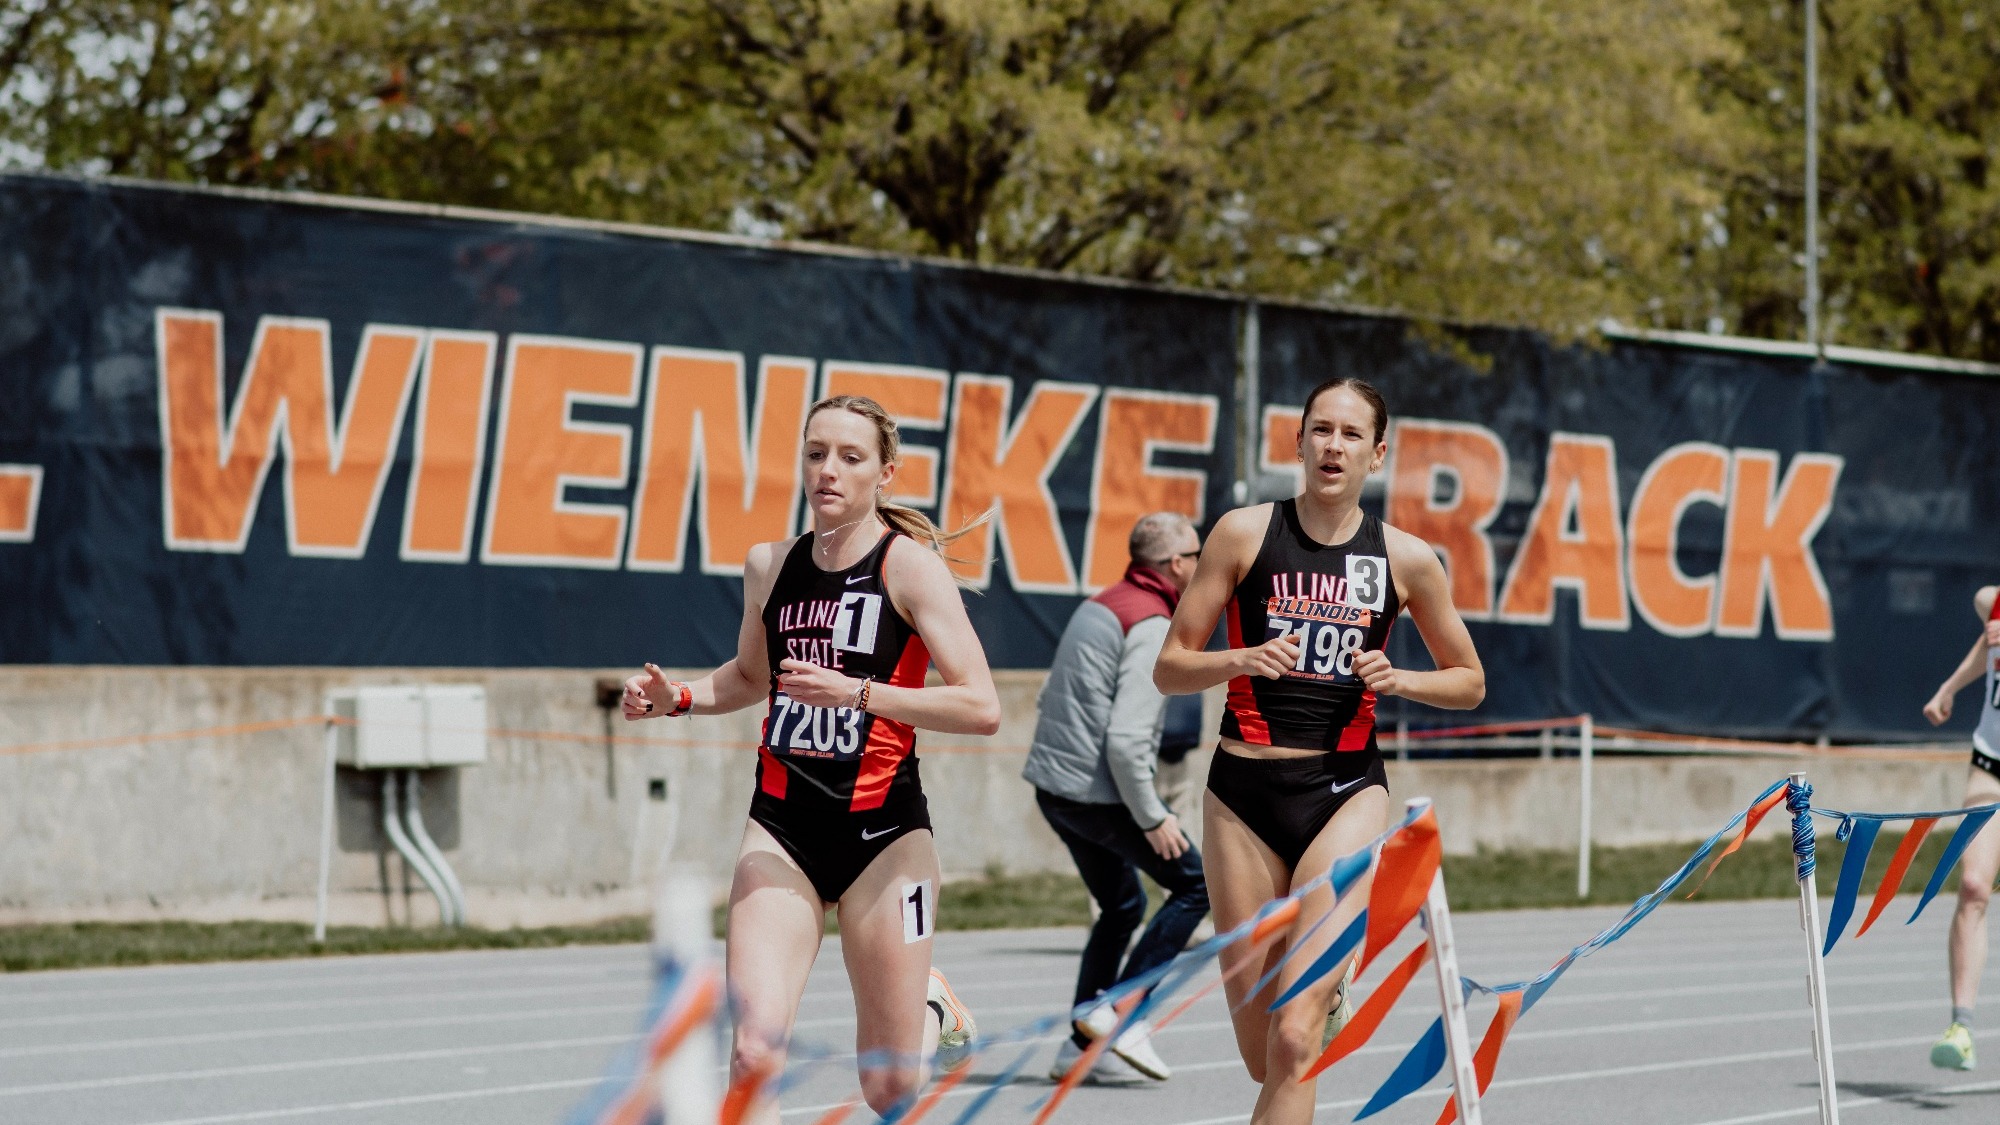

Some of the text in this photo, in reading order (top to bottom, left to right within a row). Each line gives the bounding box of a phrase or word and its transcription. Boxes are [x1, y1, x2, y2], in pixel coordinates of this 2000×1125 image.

[1260, 403, 1844, 642] RACK
[1272, 571, 1349, 606] ILLINO
[1354, 558, 1379, 605] 3
[779, 600, 841, 633] ILLINO
[844, 595, 867, 648] 1
[1276, 598, 1363, 622] ILLINOIS
[786, 638, 844, 669] STATE
[1268, 618, 1364, 676] 7198
[770, 695, 861, 754] 7203
[907, 885, 924, 937] 1
